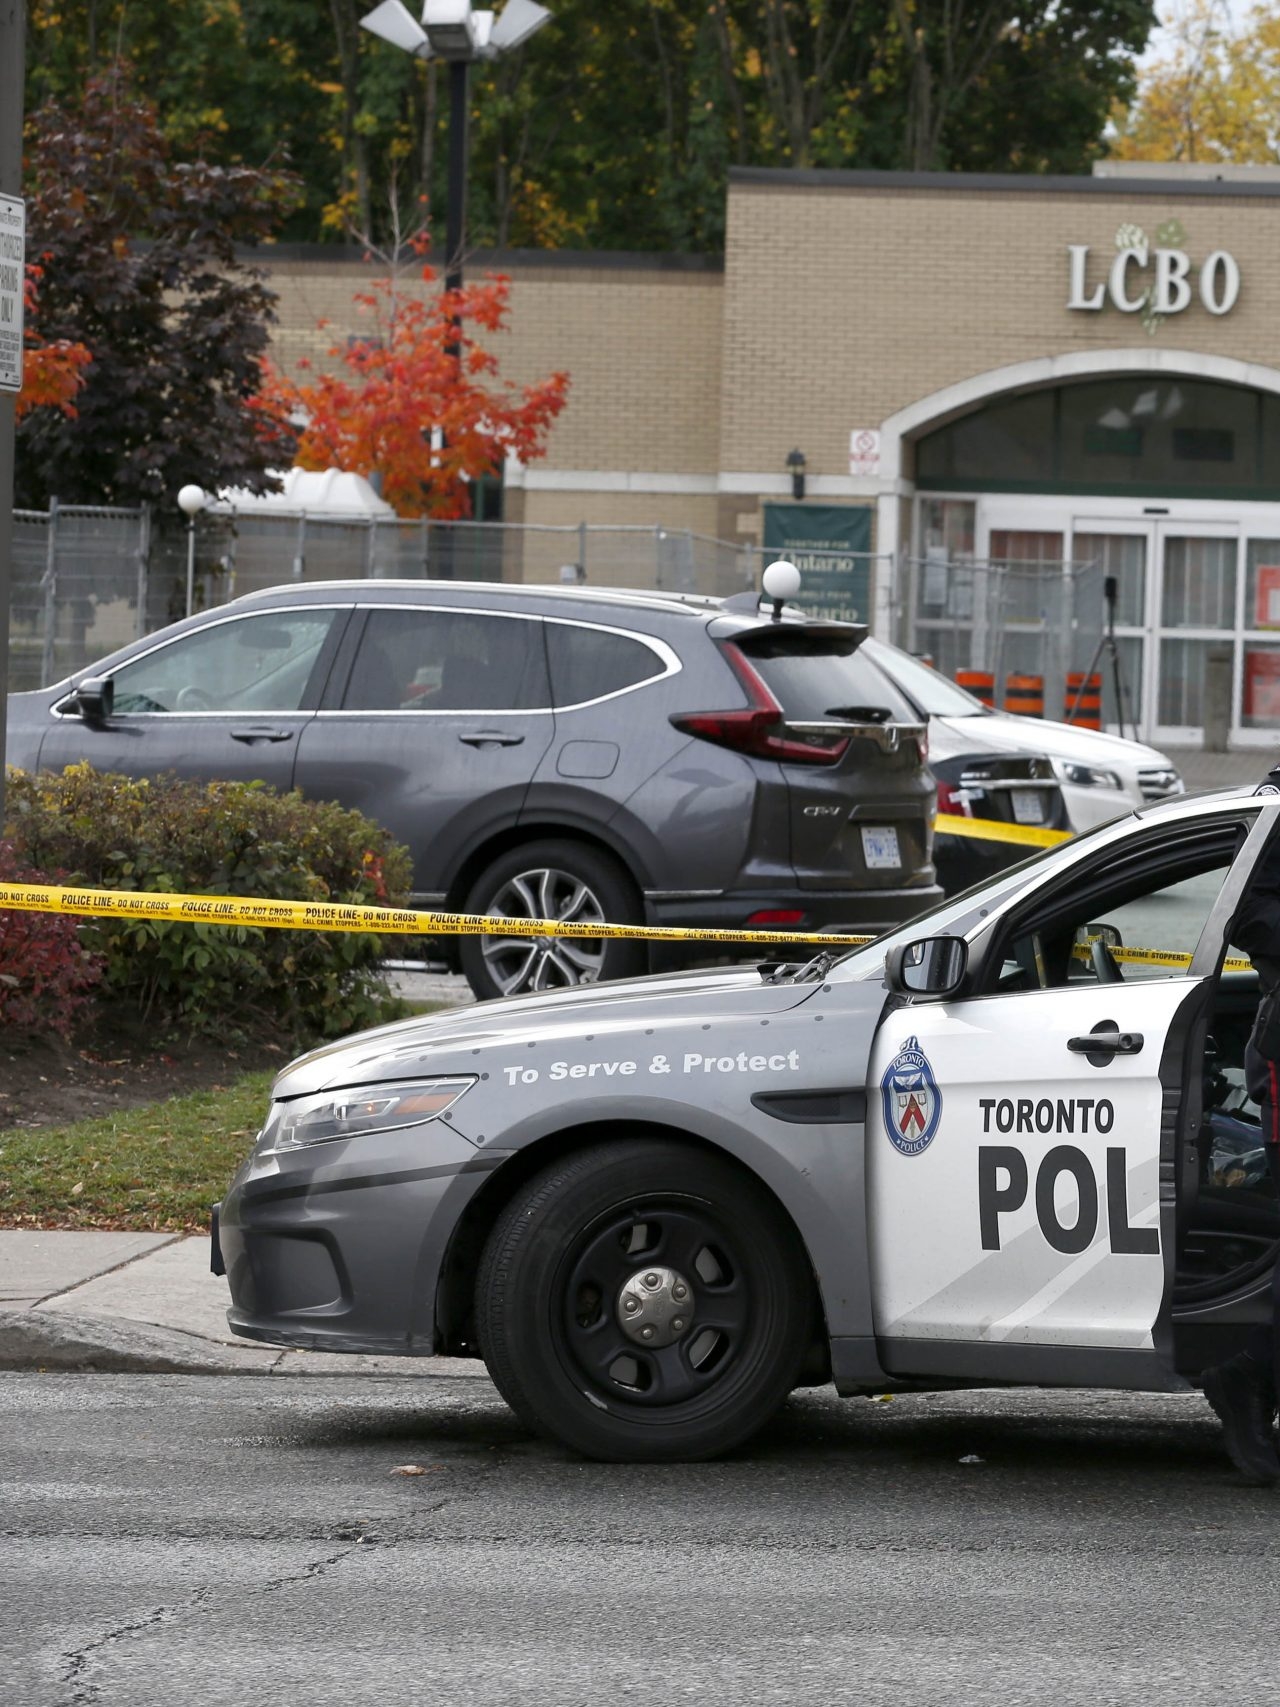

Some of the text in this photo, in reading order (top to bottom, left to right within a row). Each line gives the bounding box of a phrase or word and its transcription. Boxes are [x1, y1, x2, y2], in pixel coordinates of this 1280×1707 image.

[1066, 245, 1240, 315] LCBO
[11, 893, 24, 901] NOT
[26, 893, 49, 902] CROSS
[61, 894, 91, 906] POLICE
[118, 899, 127, 907] DO
[130, 900, 143, 909] NOT
[146, 901, 170, 910] CROSS
[181, 902, 213, 912] POLICE
[240, 906, 250, 914] DO
[252, 907, 267, 915] NOT
[305, 907, 335, 918] POLICE
[363, 912, 373, 920] DO
[376, 912, 390, 921] NOT
[392, 913, 417, 922] CROSS
[429, 913, 460, 924] POLICE
[489, 917, 500, 925] DO
[503, 1049, 800, 1086] To Serve & Protect
[893, 1053, 925, 1071] TORONTO
[979, 1098, 1115, 1133] TORONTO
[901, 1138, 925, 1153] POLICE
